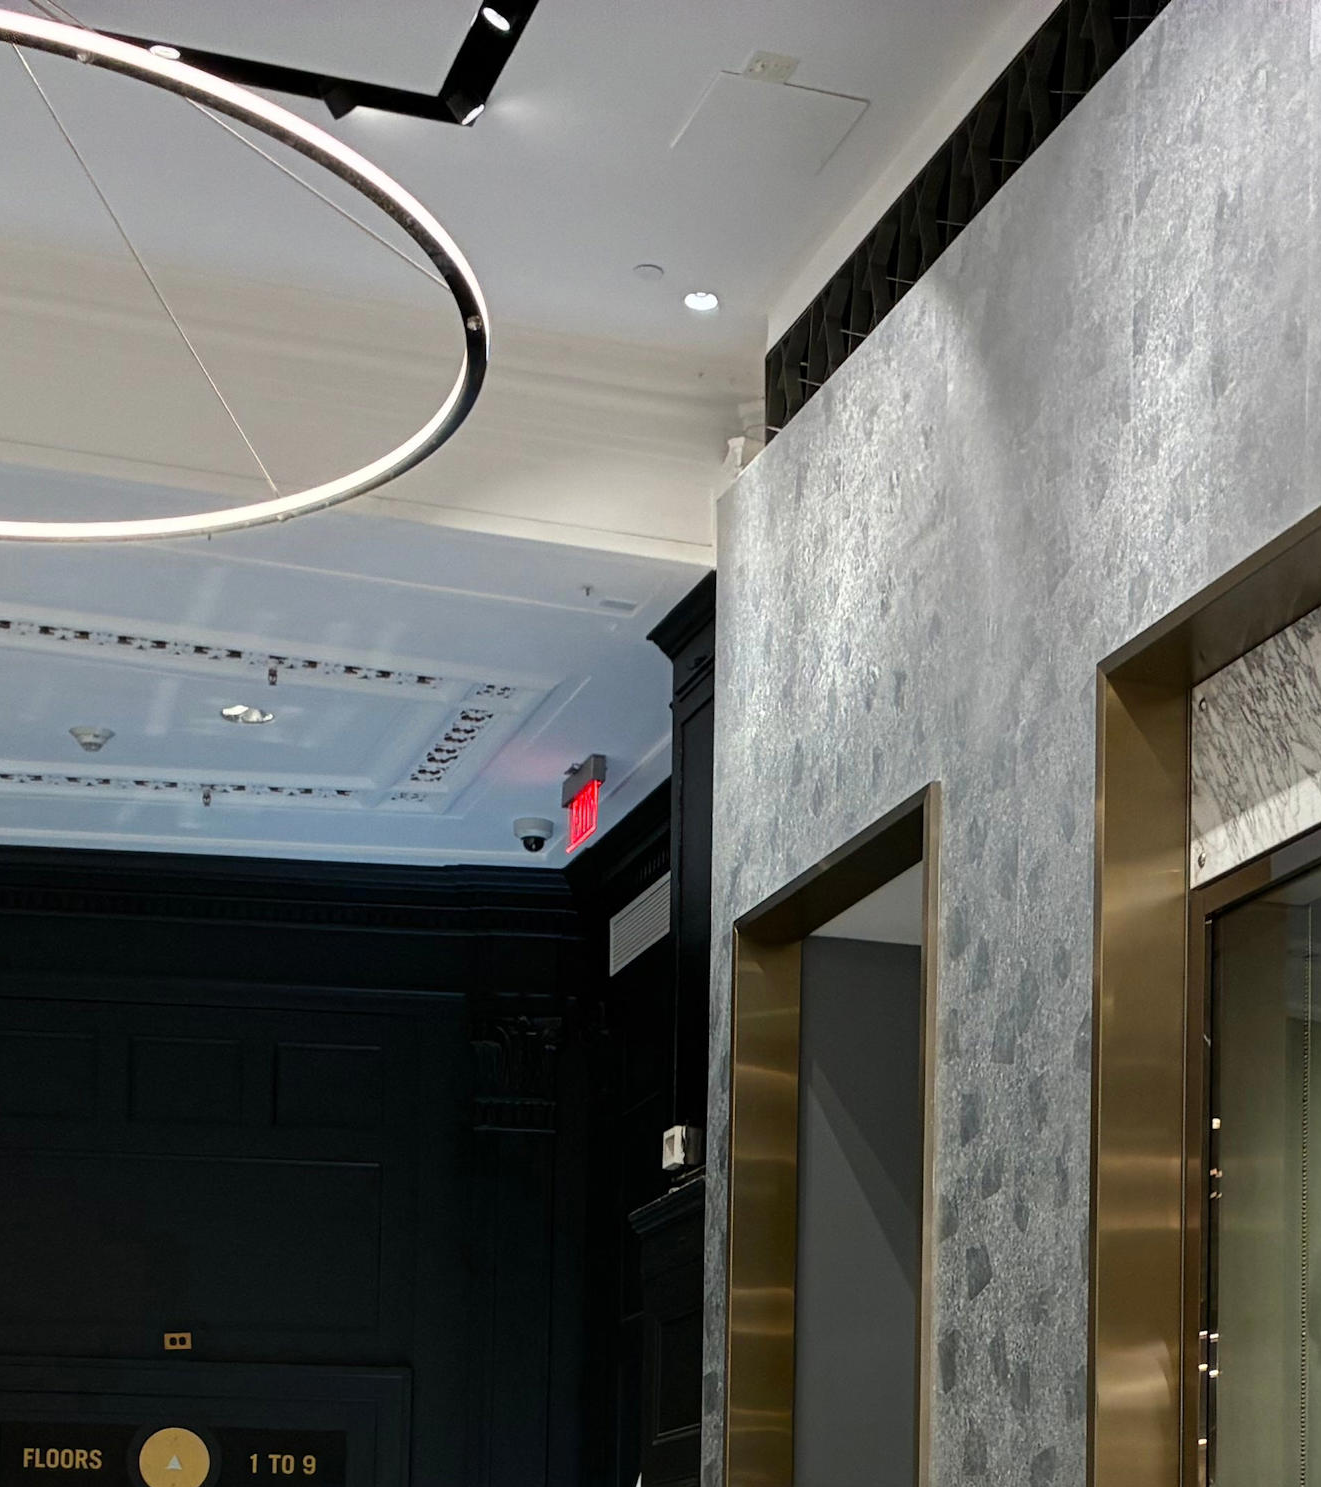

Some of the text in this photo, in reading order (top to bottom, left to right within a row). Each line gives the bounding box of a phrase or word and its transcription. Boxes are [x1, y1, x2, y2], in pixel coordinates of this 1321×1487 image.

[23, 1448, 317, 1475] FLOORS 1 TO 9
